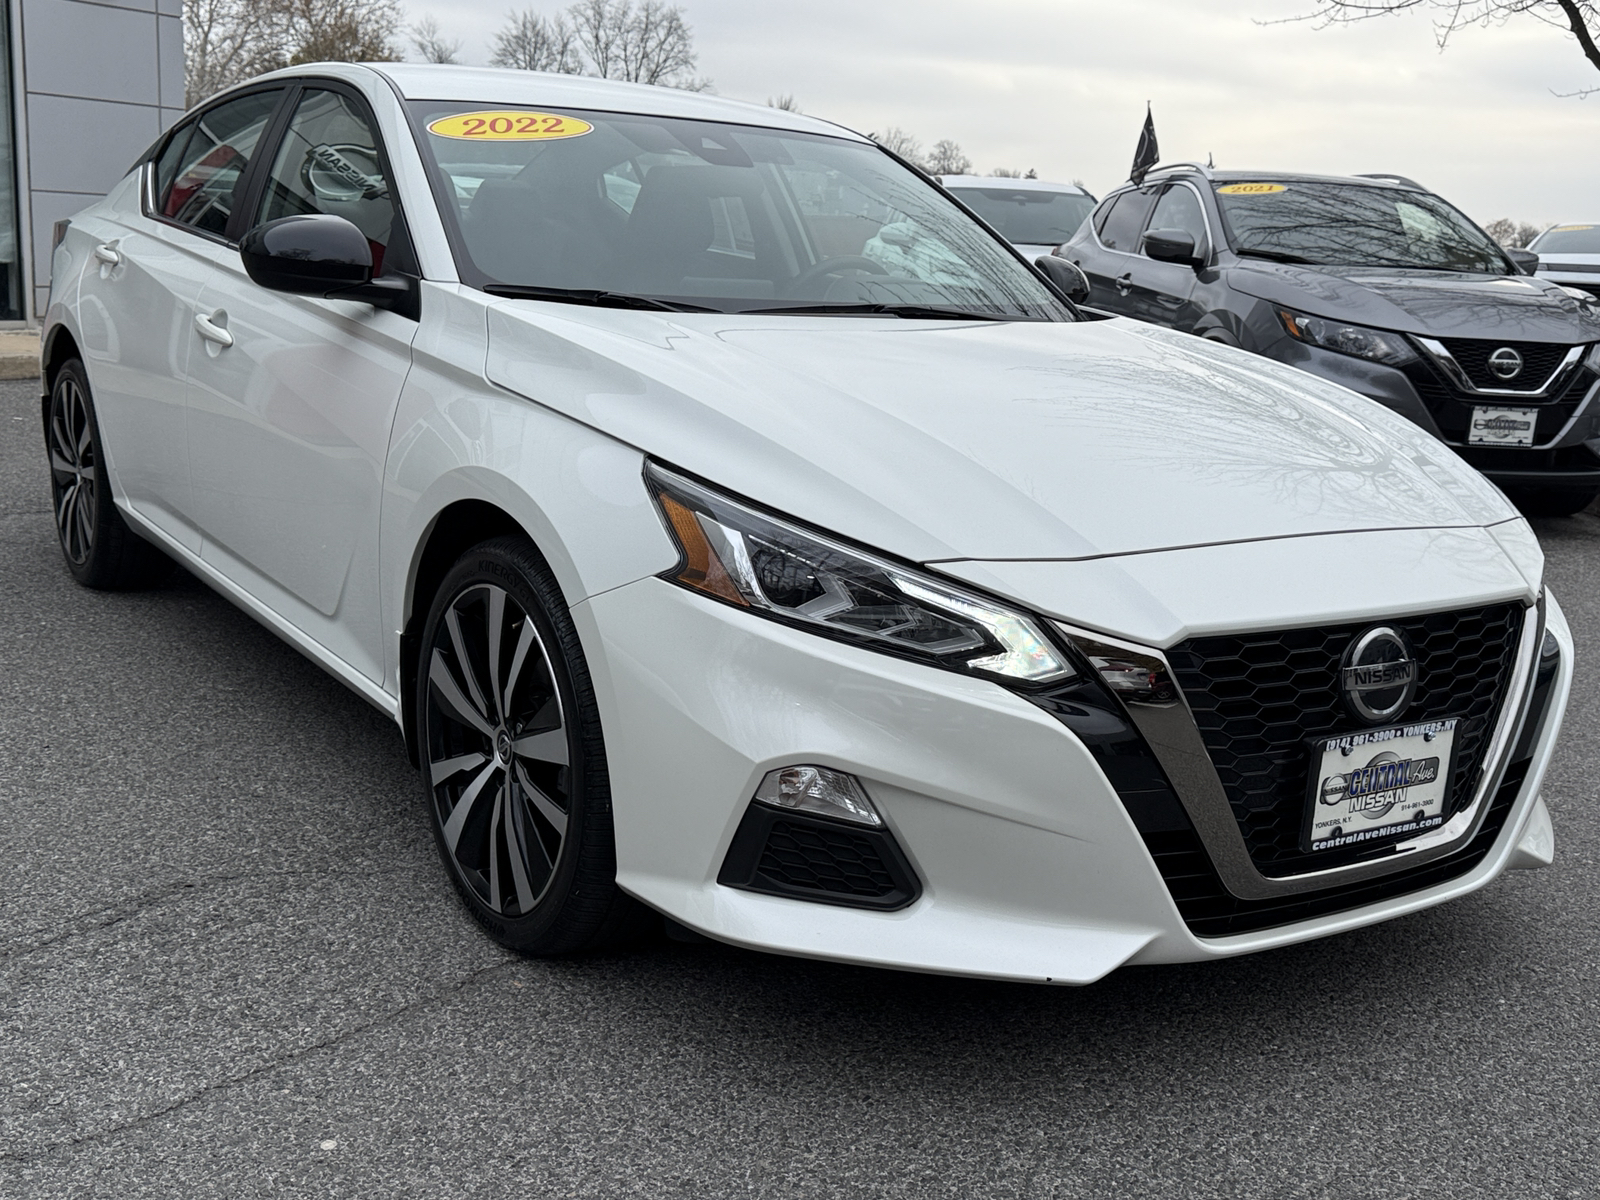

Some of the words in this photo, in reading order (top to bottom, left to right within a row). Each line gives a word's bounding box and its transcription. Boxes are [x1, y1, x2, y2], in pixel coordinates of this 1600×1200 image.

[462, 117, 565, 136] 2022
[1231, 185, 1274, 193] 2021
[1354, 664, 1411, 686] NISSAN
[1349, 759, 1412, 797] CENTRAL
[1412, 760, 1435, 783] Ave.
[1349, 787, 1408, 813] NISSAN
[1312, 817, 1443, 851] CentralAveNissan.com
